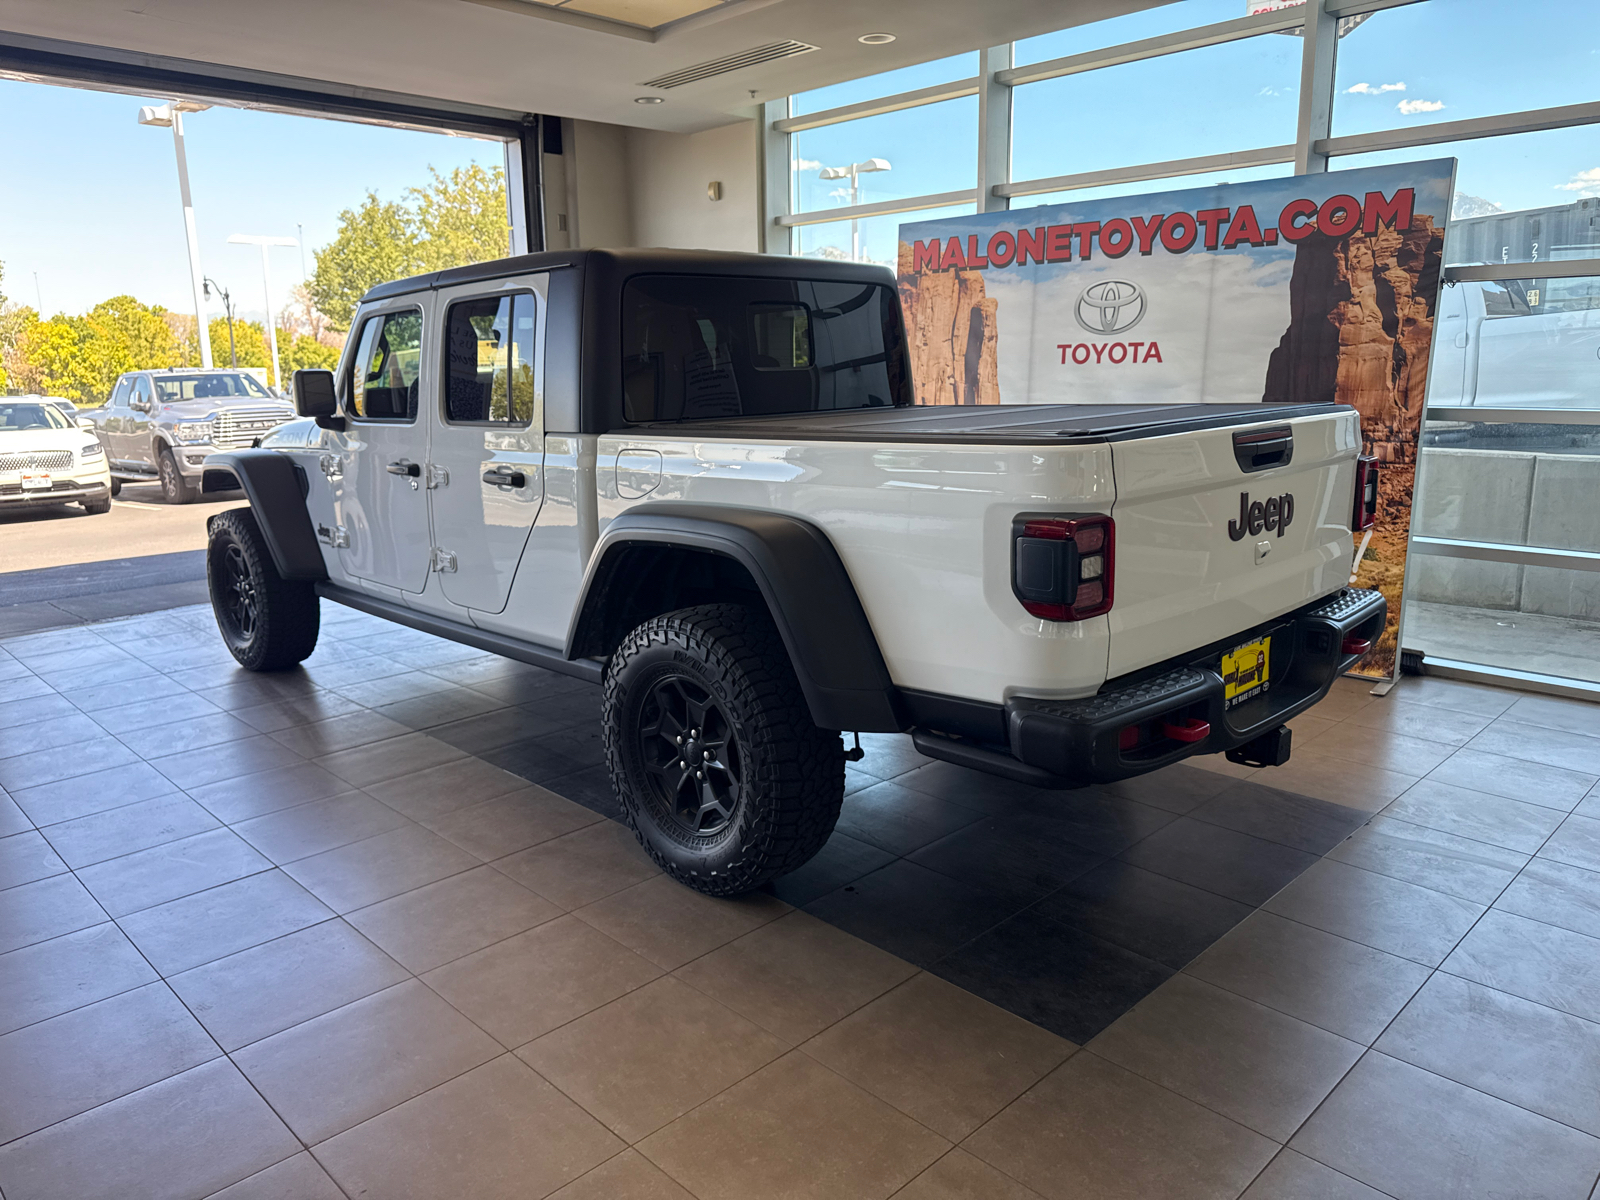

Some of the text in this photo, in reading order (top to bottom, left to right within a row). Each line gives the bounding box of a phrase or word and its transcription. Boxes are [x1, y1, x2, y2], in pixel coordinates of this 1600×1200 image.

[912, 188, 1416, 274] MALONETOYOTA.COM
[1056, 341, 1164, 366] TOYOTA
[1228, 491, 1294, 542] Jeep
